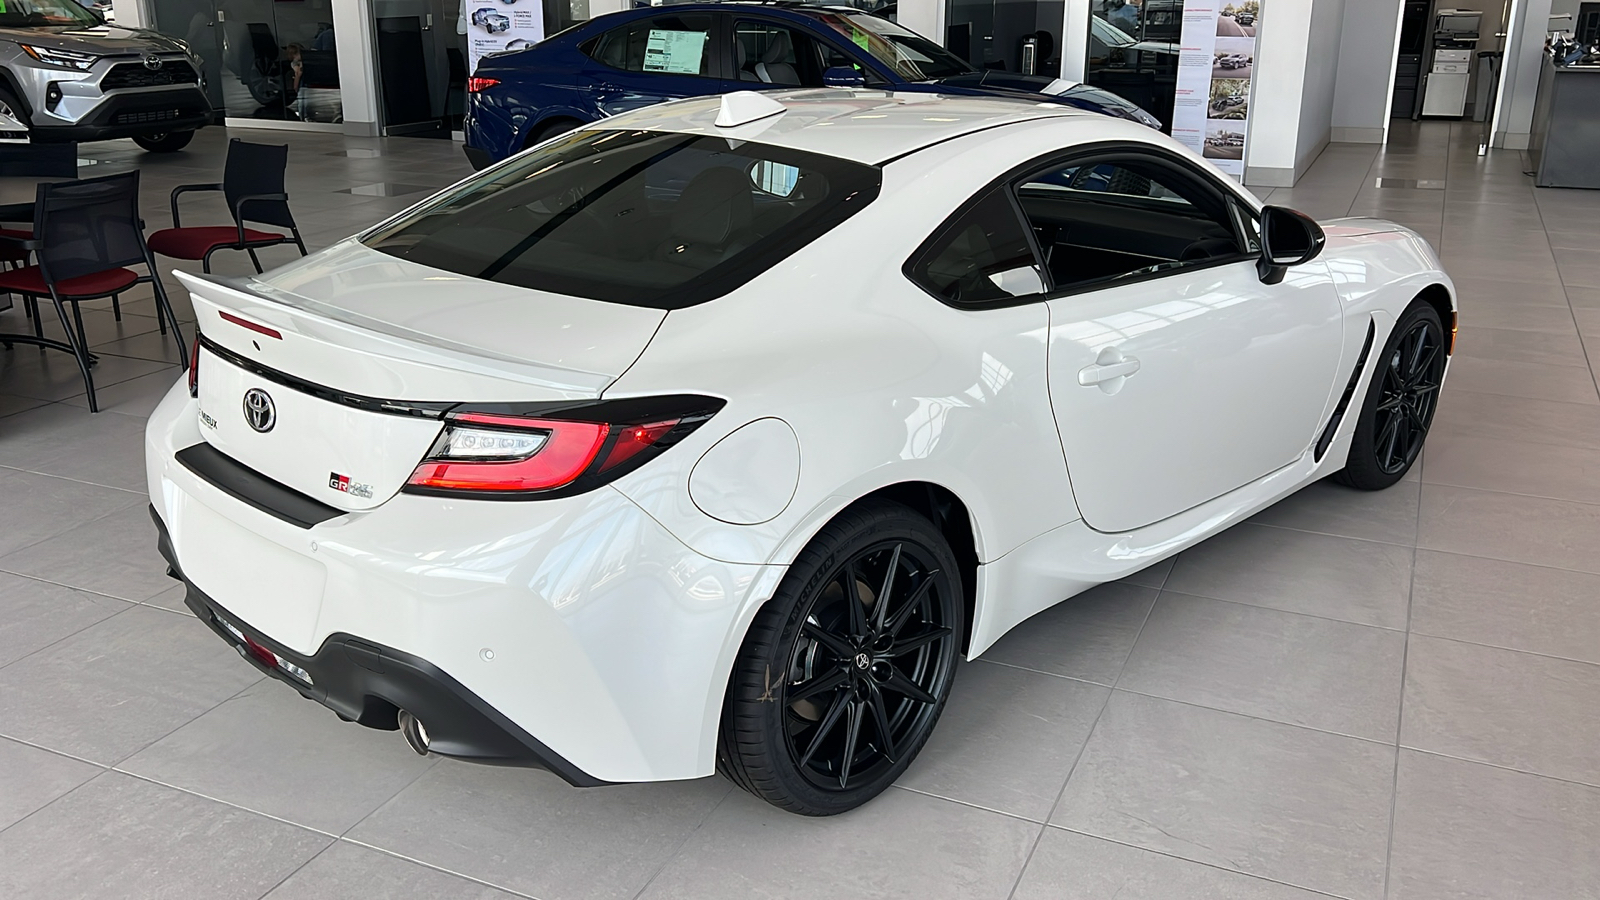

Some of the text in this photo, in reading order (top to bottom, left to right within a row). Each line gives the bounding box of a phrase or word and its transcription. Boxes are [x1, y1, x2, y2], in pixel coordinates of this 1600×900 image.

[201, 410, 218, 430] MIEUX
[330, 477, 348, 492] GR
[791, 558, 833, 621] MICHELIN
